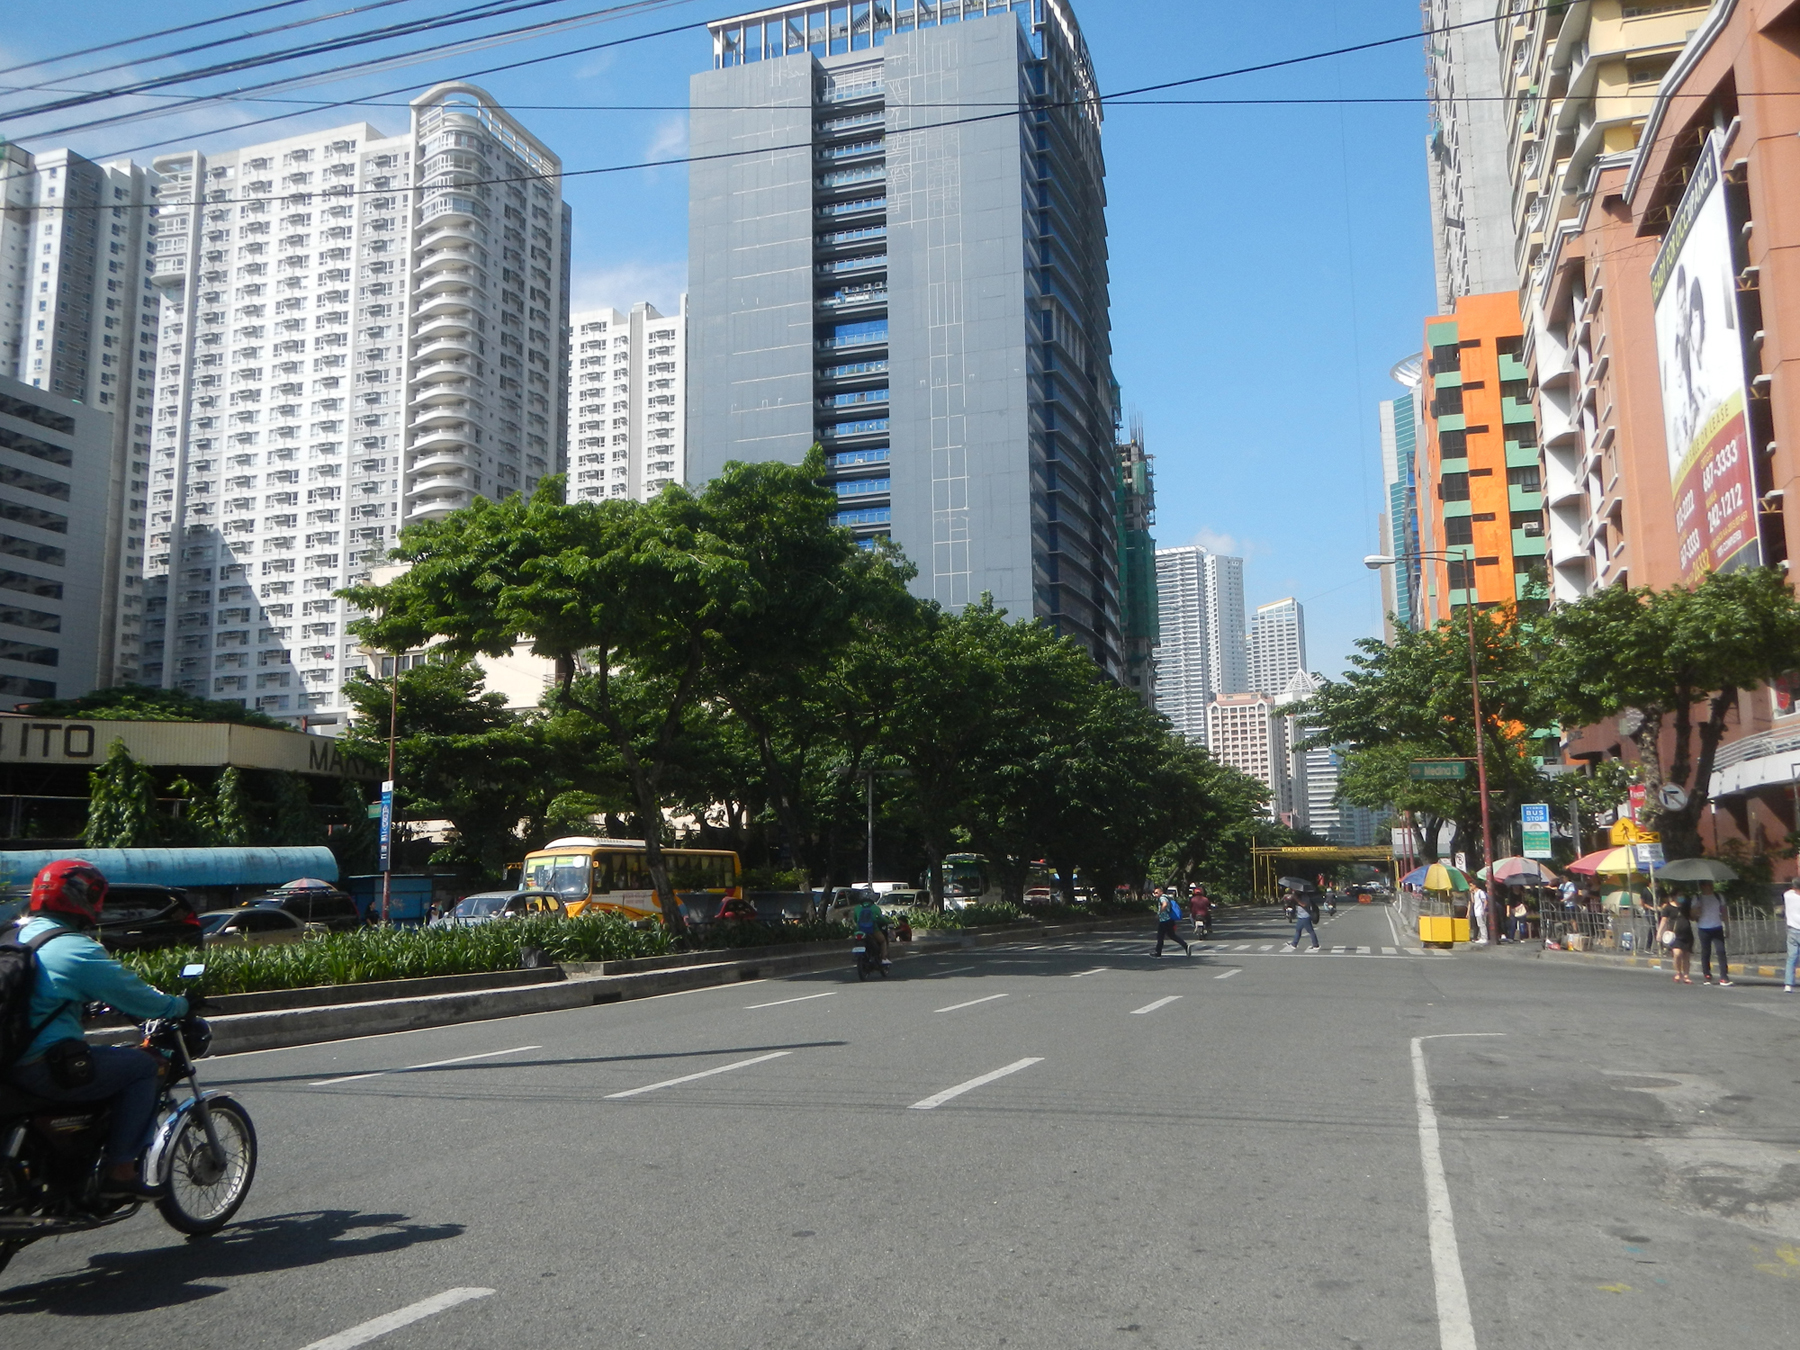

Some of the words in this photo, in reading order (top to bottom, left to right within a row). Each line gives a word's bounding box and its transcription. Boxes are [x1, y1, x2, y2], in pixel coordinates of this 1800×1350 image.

[1665, 233, 1677, 269] FOR
[1675, 151, 1714, 249] OCCUPANCY
[1709, 403, 1729, 434] LEASE
[1707, 482, 1744, 534] 242-1212
[1424, 765, 1451, 776] Medina
